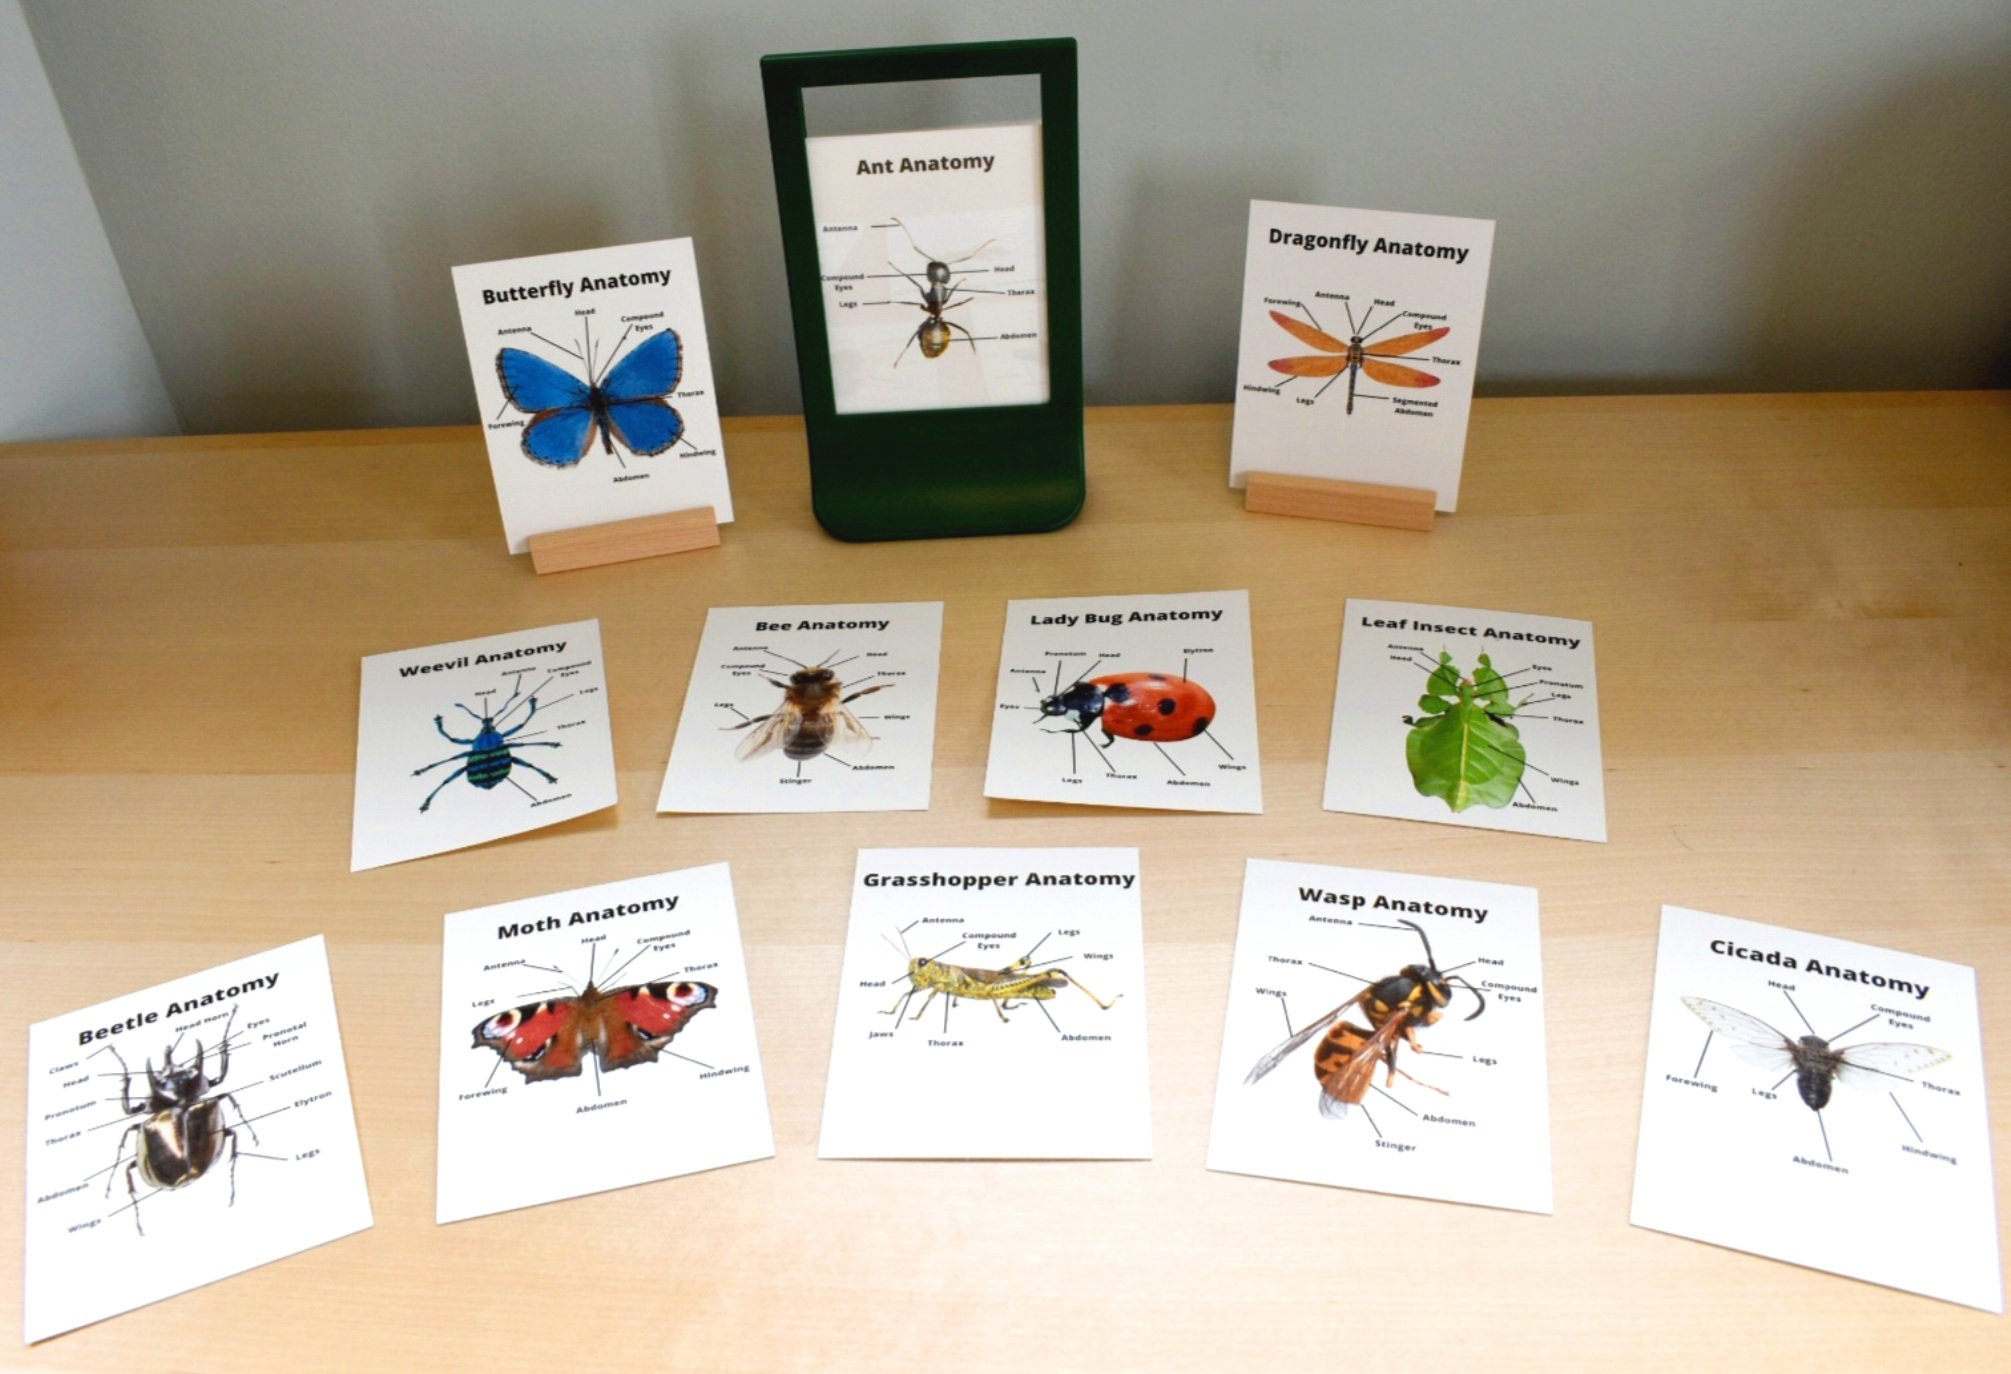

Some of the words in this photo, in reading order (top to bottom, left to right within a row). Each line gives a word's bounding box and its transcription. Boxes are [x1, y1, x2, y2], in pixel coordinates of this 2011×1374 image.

[857, 160, 893, 175] Ant
[900, 155, 995, 173] Anatomy
[823, 225, 858, 233] Antenna
[1269, 228, 1368, 255] Dragonfly
[1374, 238, 1469, 264] Anatomy
[994, 265, 1015, 273] Head
[482, 279, 574, 305] Butterfly
[580, 269, 671, 293] Anatomy
[835, 284, 852, 292] Eyes
[1264, 297, 1301, 307] Forewing
[1315, 291, 1349, 301] Antenna
[839, 300, 857, 308] Legs
[1374, 298, 1395, 307] Head
[575, 308, 595, 316] Head
[621, 311, 664, 323] Compound
[1403, 310, 1447, 321] Compound
[498, 325, 532, 335] Antenna
[635, 323, 653, 332] Eyes
[1414, 322, 1432, 330] Eyes
[1000, 331, 1037, 340] Abdomen
[1432, 357, 1460, 366] Thorax
[678, 389, 704, 398] Thorax
[1243, 385, 1280, 395] Hindwing
[1296, 397, 1314, 405] Legs
[1393, 397, 1438, 408] Segmented
[1395, 408, 1433, 417] Abdomen
[680, 448, 716, 459] Hindwing
[613, 472, 649, 483] Abdomen
[1031, 615, 1079, 627] Lady
[1085, 613, 1123, 625] Bug
[1128, 610, 1223, 622] Anatomy
[755, 621, 792, 631] Bee
[797, 619, 890, 631] Anatomy
[1362, 617, 1407, 630] Leaf
[1414, 621, 1477, 636] Insect
[1484, 627, 1581, 649] Anatomy
[400, 657, 469, 677] Weevil
[475, 641, 567, 665] Anatomy
[561, 670, 579, 678] Eyes
[579, 687, 598, 695] Legs
[1551, 692, 1571, 700] Legs
[557, 720, 586, 730] Thorax
[1553, 716, 1584, 724] Thorax
[1551, 777, 1579, 786] Wings
[1512, 802, 1558, 812] Abdomen
[863, 873, 1019, 890] Grasshopper
[1025, 873, 1135, 889] Anatomy
[1299, 887, 1366, 910] Wasp
[1373, 895, 1488, 923] Anatomy
[498, 916, 561, 940] Moth
[568, 895, 679, 926] Anatomy
[1309, 915, 1352, 926] Antenna
[581, 934, 606, 944] Head
[636, 929, 690, 946] Compound
[962, 932, 1017, 941] Compound
[654, 942, 676, 951] Eyes
[483, 958, 526, 971] Antenna
[1268, 956, 1302, 965] Thorax
[1478, 957, 1504, 966] Head
[684, 962, 718, 973] Thorax
[1710, 940, 1797, 969] Cicada
[1805, 959, 1930, 999] Anatomy
[1481, 981, 1538, 994] Compound
[1768, 980, 1796, 991] Head
[1256, 987, 1287, 998] Wings
[1498, 993, 1521, 1003] Eyes
[472, 998, 494, 1008] Legs
[79, 1012, 158, 1046] Beetle
[166, 973, 280, 1018] Anatomy
[1871, 1004, 1931, 1023] Compound
[175, 1022, 201, 1033] Head
[204, 1012, 229, 1024] Horn
[248, 1017, 270, 1030] Eyes
[1889, 1018, 1913, 1030] Eyes
[262, 1022, 307, 1041] Pronotal
[273, 1034, 299, 1048] Horn
[1473, 1056, 1497, 1066] Legs
[49, 1060, 79, 1075] Claws
[269, 1059, 322, 1081] Scutellum
[700, 1064, 750, 1080] Hindwing
[63, 1075, 89, 1088] Head
[1666, 1074, 1718, 1093] Forewing
[459, 1086, 508, 1100] Forewing
[1752, 1088, 1777, 1100] Legs
[1922, 1081, 1961, 1096] Thorax
[295, 1090, 332, 1108] Elytron
[44, 1100, 97, 1121] Pronotum
[576, 1099, 627, 1114] Abdomen
[1423, 1114, 1476, 1127] Abdomen
[45, 1130, 82, 1147] Thorax
[1375, 1140, 1416, 1153] Stinger
[295, 1149, 320, 1161] Legs
[1902, 1144, 1957, 1165] Hindwing
[1793, 1156, 1849, 1174] Abdomen
[38, 1182, 89, 1203] Abdomen
[68, 1218, 101, 1233] Wings
